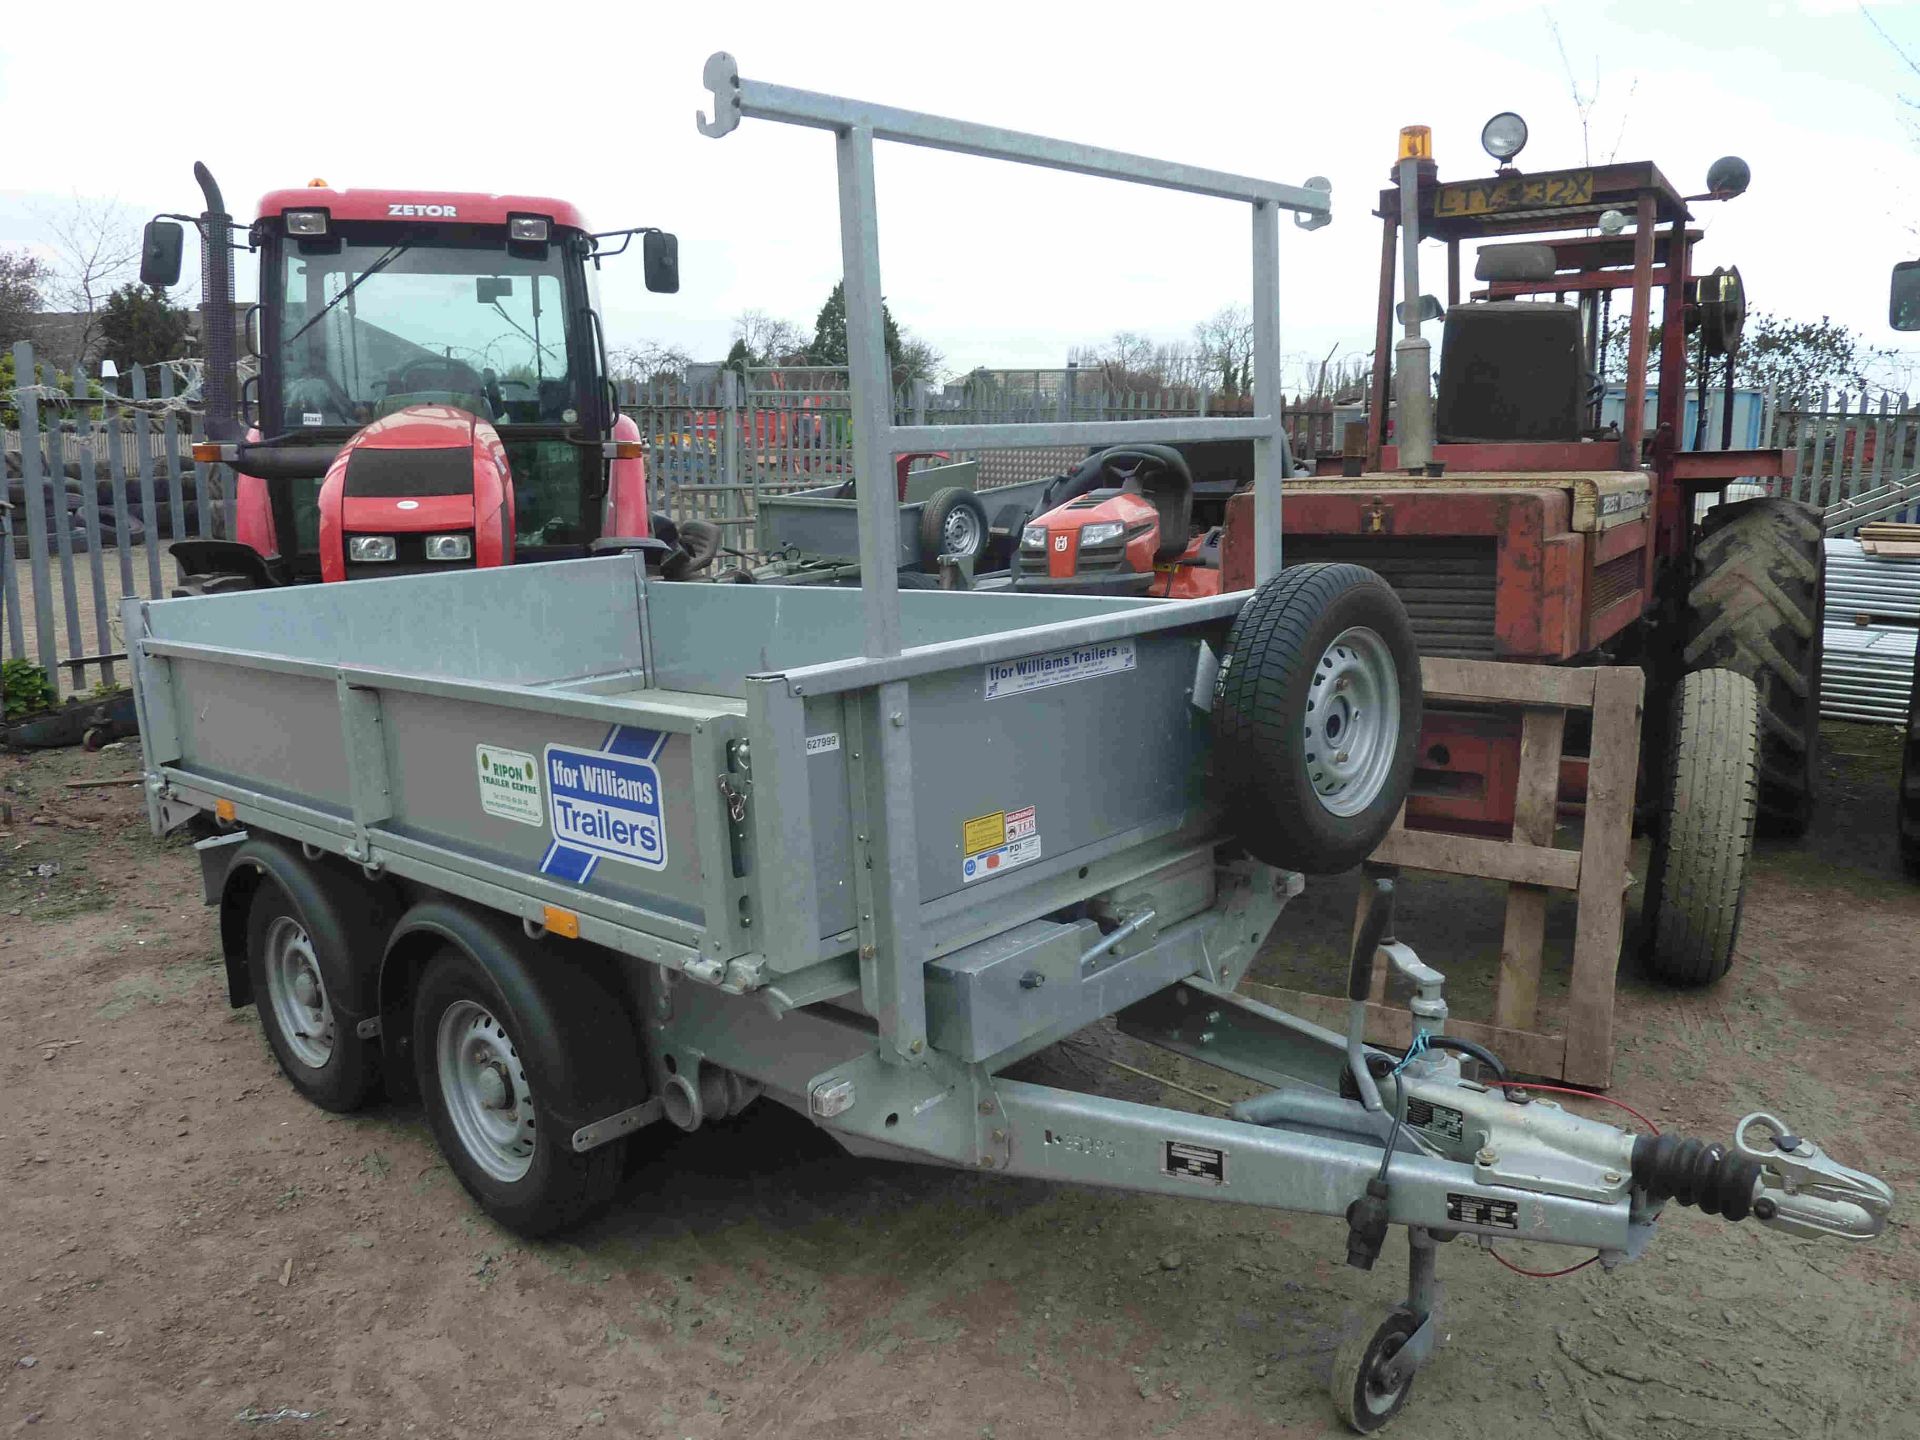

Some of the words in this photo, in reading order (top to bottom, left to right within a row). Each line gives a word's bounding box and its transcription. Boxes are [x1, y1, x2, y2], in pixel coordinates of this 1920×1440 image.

[1438, 184, 1496, 213] LTY
[388, 204, 457, 217] ZETOR
[990, 667, 1014, 681] Ifor
[1016, 656, 1070, 676] Williams
[1072, 646, 1118, 664] Trailers
[807, 735, 836, 750] 627999
[493, 763, 523, 781] RIPON
[552, 759, 578, 789] Ifor
[580, 764, 653, 805] Williams
[482, 775, 510, 788] TRAILER
[511, 782, 537, 795] CENTRE
[557, 799, 657, 851] Trailers
[1010, 843, 1022, 853] PDI
